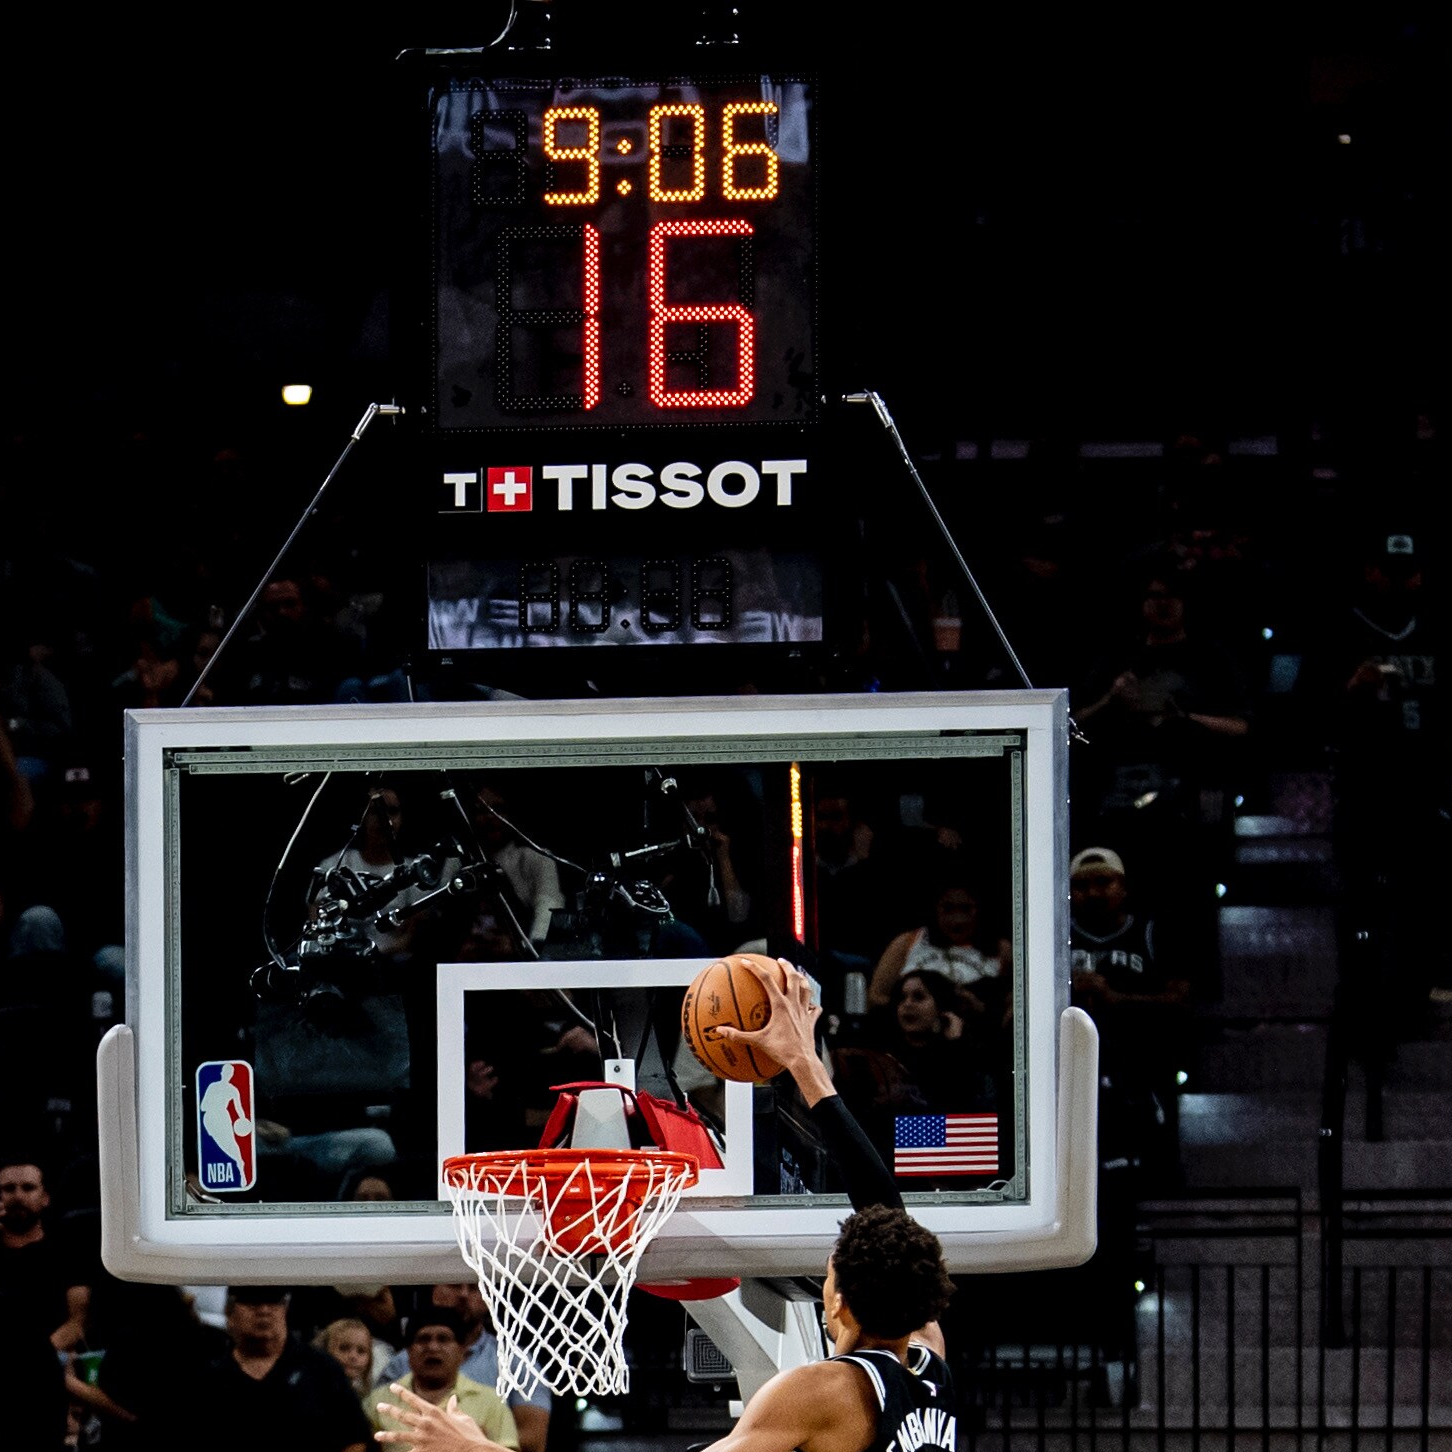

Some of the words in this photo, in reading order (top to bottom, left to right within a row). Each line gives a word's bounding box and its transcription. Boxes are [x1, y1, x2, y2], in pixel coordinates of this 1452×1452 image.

[543, 102, 778, 205] 9:06
[584, 220, 754, 409] 16
[543, 459, 807, 511] TISSOT
[207, 1162, 234, 1183] NBA
